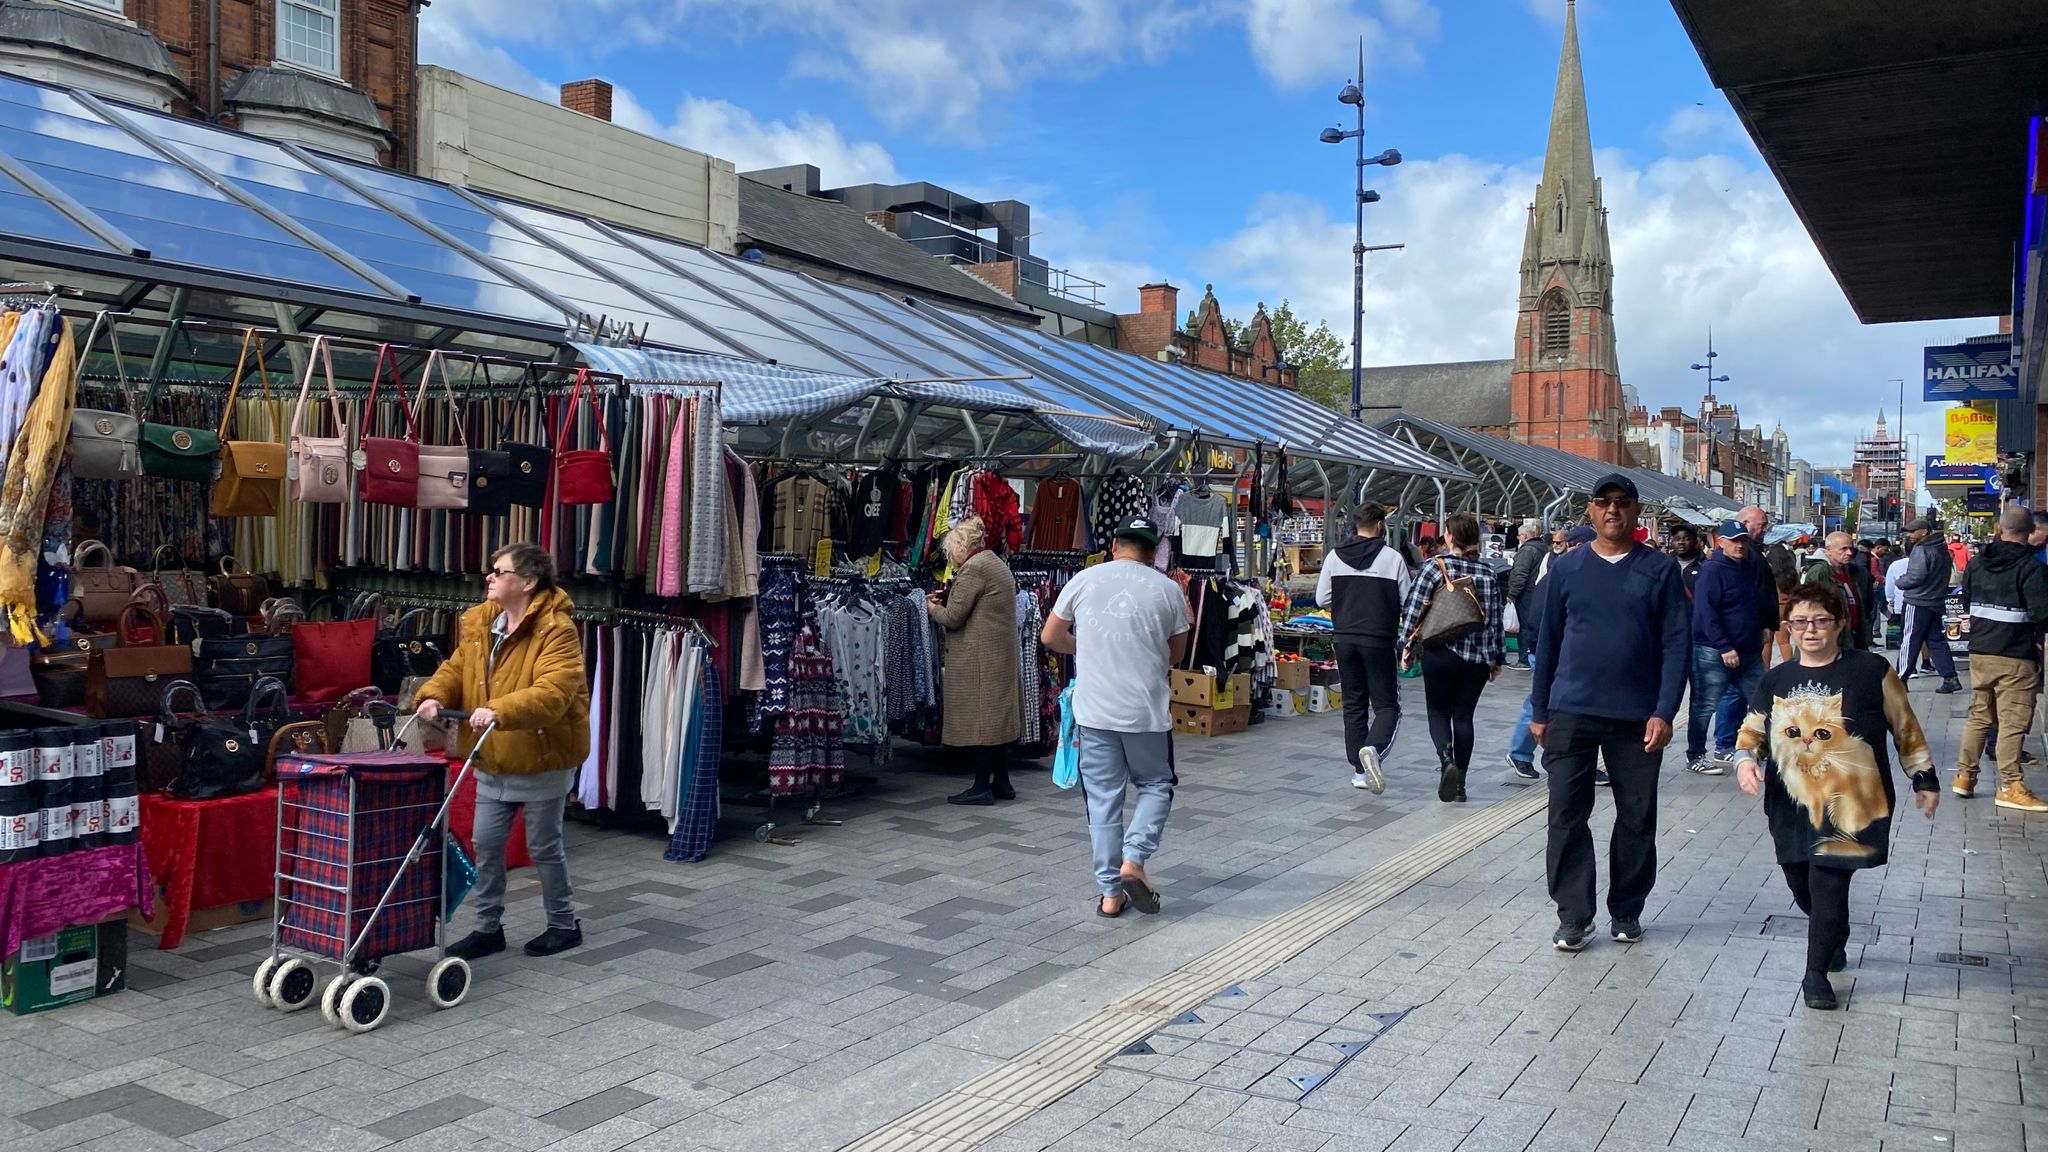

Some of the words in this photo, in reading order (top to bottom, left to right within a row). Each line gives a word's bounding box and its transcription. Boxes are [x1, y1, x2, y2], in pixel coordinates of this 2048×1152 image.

[1927, 365, 2017, 380] HALIFAX
[10, 766, 23, 783] 50
[12, 816, 26, 834] 50
[88, 816, 100, 832] 50
